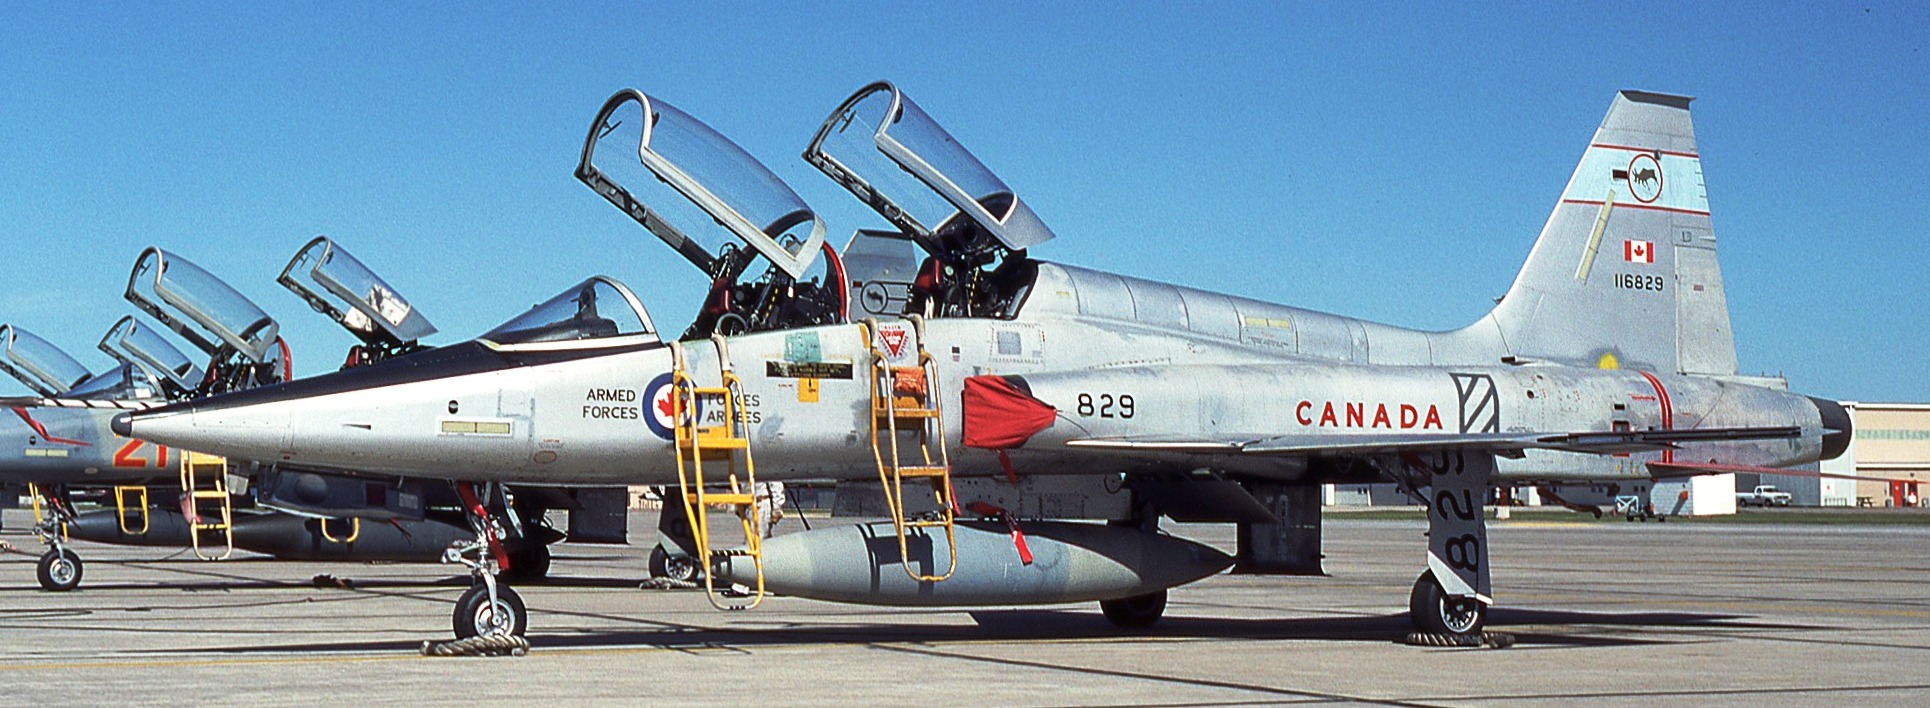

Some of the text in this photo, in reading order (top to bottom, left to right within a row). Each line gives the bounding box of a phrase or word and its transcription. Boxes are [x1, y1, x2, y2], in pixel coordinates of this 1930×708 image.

[1614, 273, 1664, 292] 116829
[586, 388, 636, 402] ARMED
[708, 393, 760, 407] FOCES
[582, 405, 638, 419] FORCES
[1077, 393, 1135, 419] 829
[1295, 400, 1443, 430] CANADA
